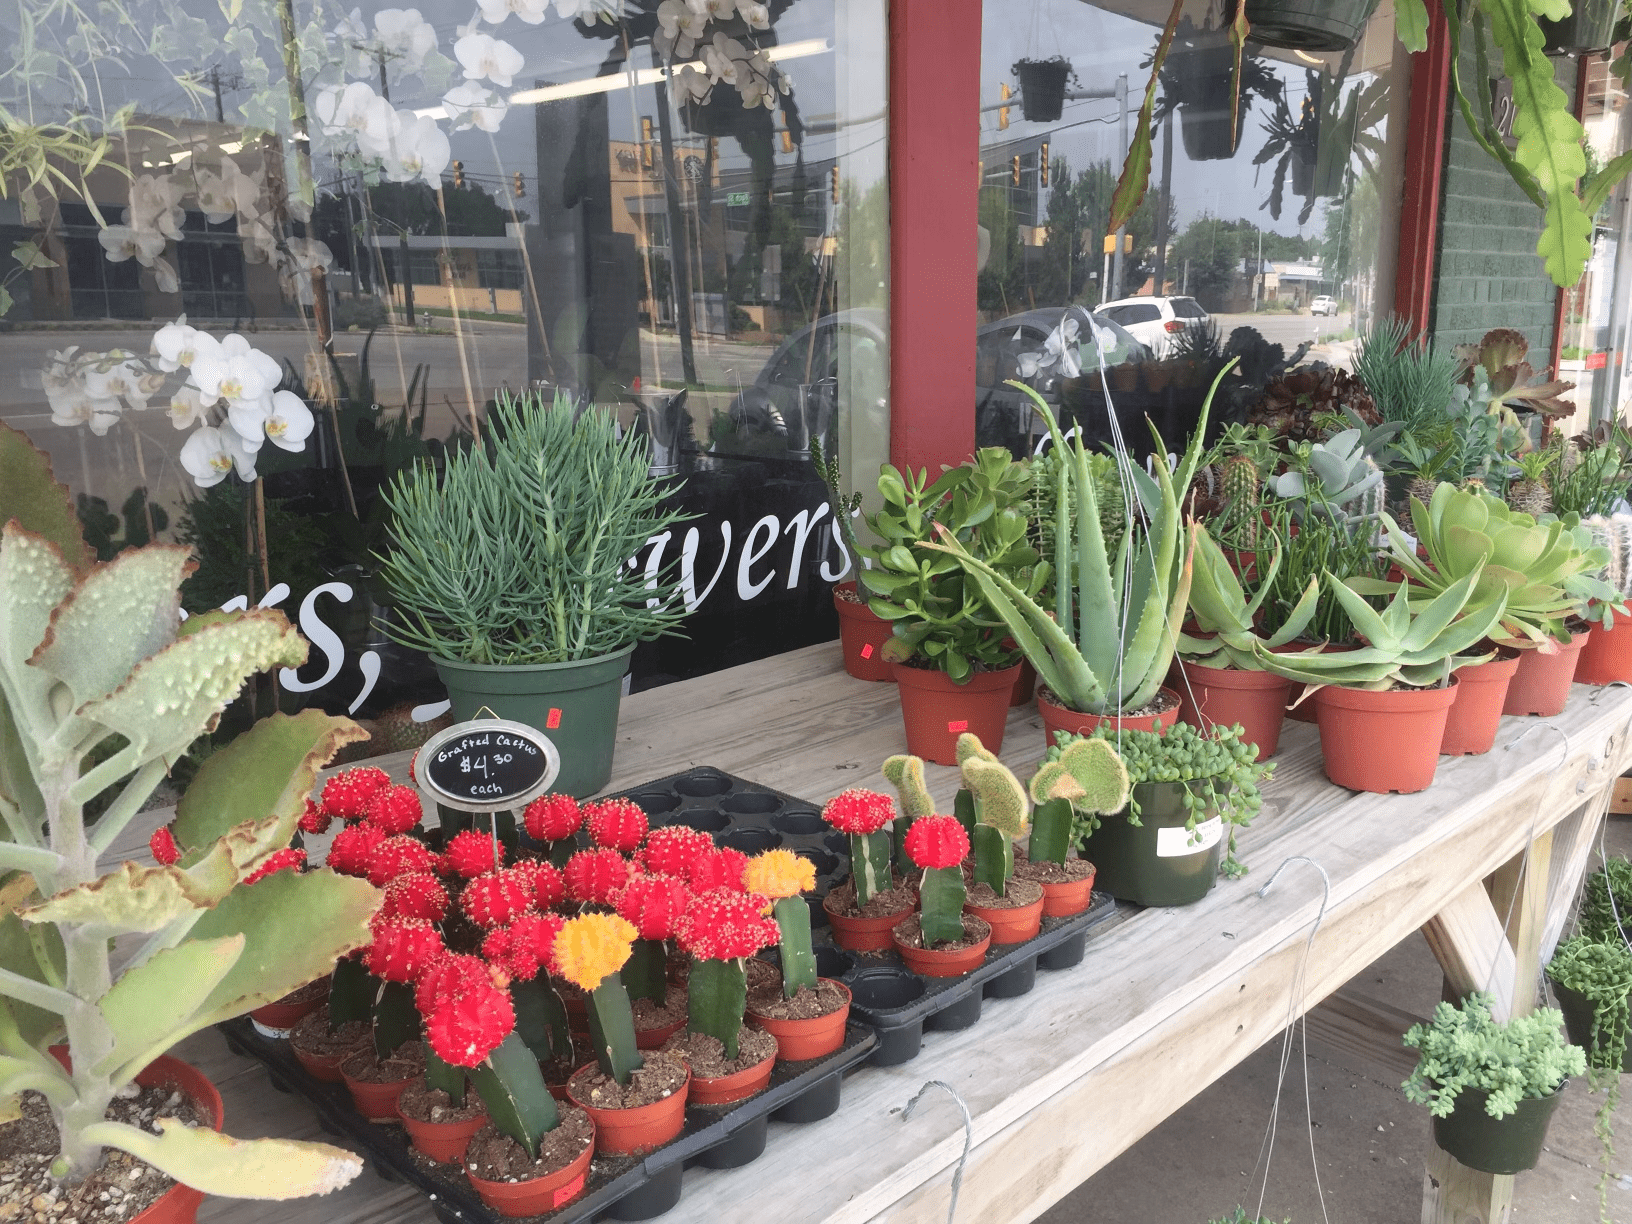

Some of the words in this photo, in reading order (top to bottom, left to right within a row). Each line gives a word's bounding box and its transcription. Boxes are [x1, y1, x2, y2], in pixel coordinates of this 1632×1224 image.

[438, 733, 490, 763] Grafted
[496, 734, 537, 756] Cactus
[470, 782, 503, 795] each
